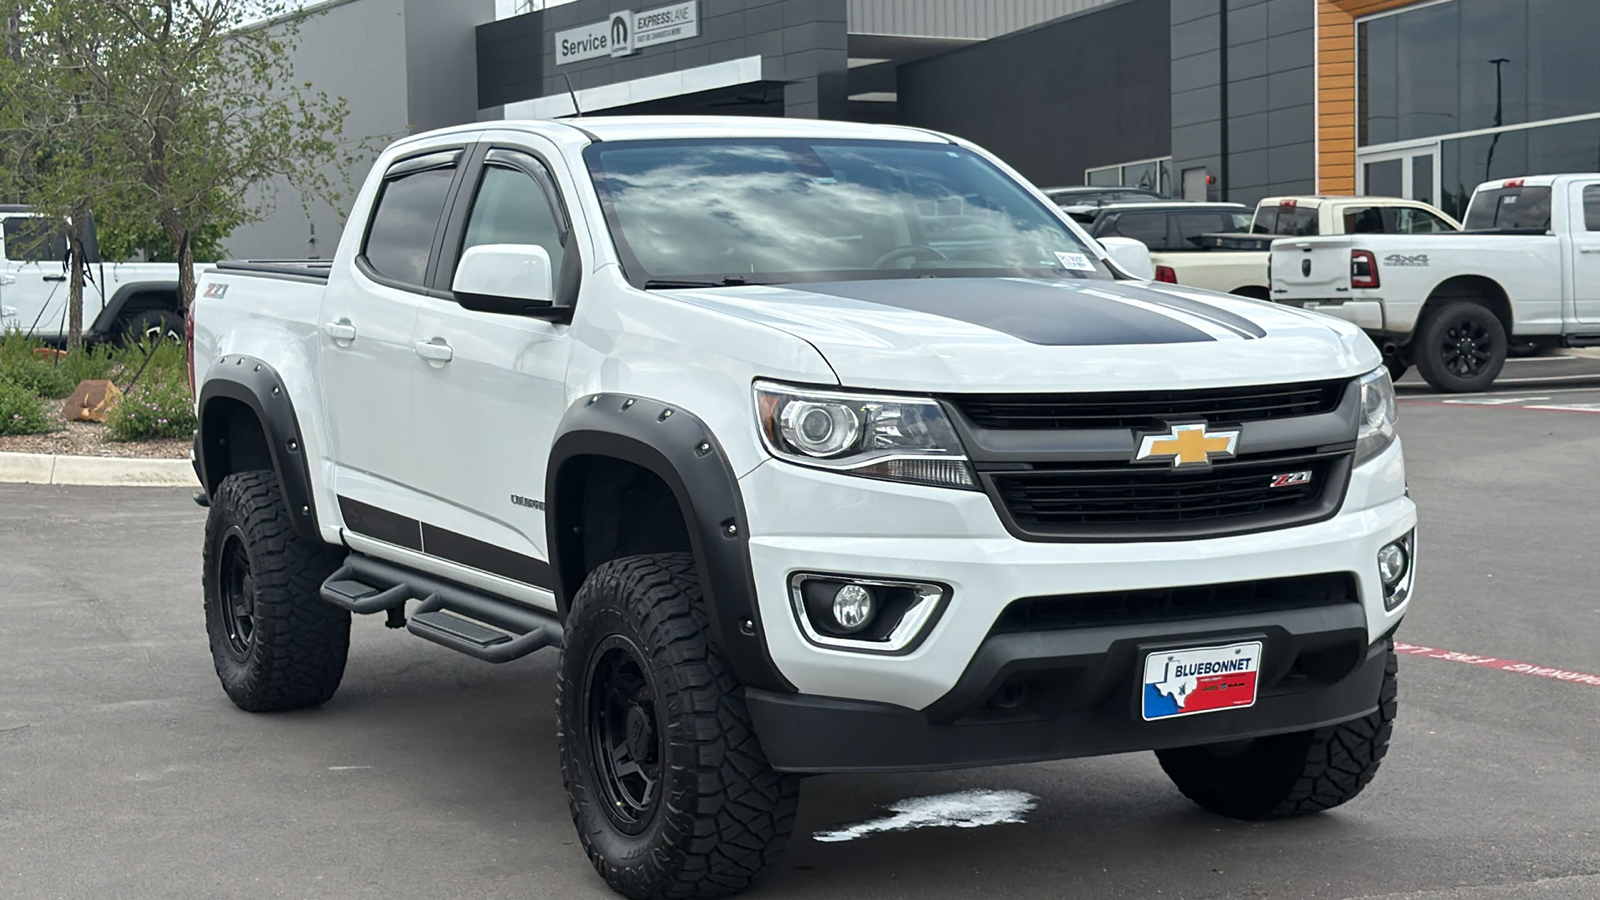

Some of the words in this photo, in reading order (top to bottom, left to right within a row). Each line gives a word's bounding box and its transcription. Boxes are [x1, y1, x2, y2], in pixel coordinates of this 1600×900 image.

[561, 34, 607, 57] Service
[203, 283, 229, 299] Z71
[1270, 470, 1312, 487] Z71
[1175, 658, 1251, 677] BLUEBONNET
